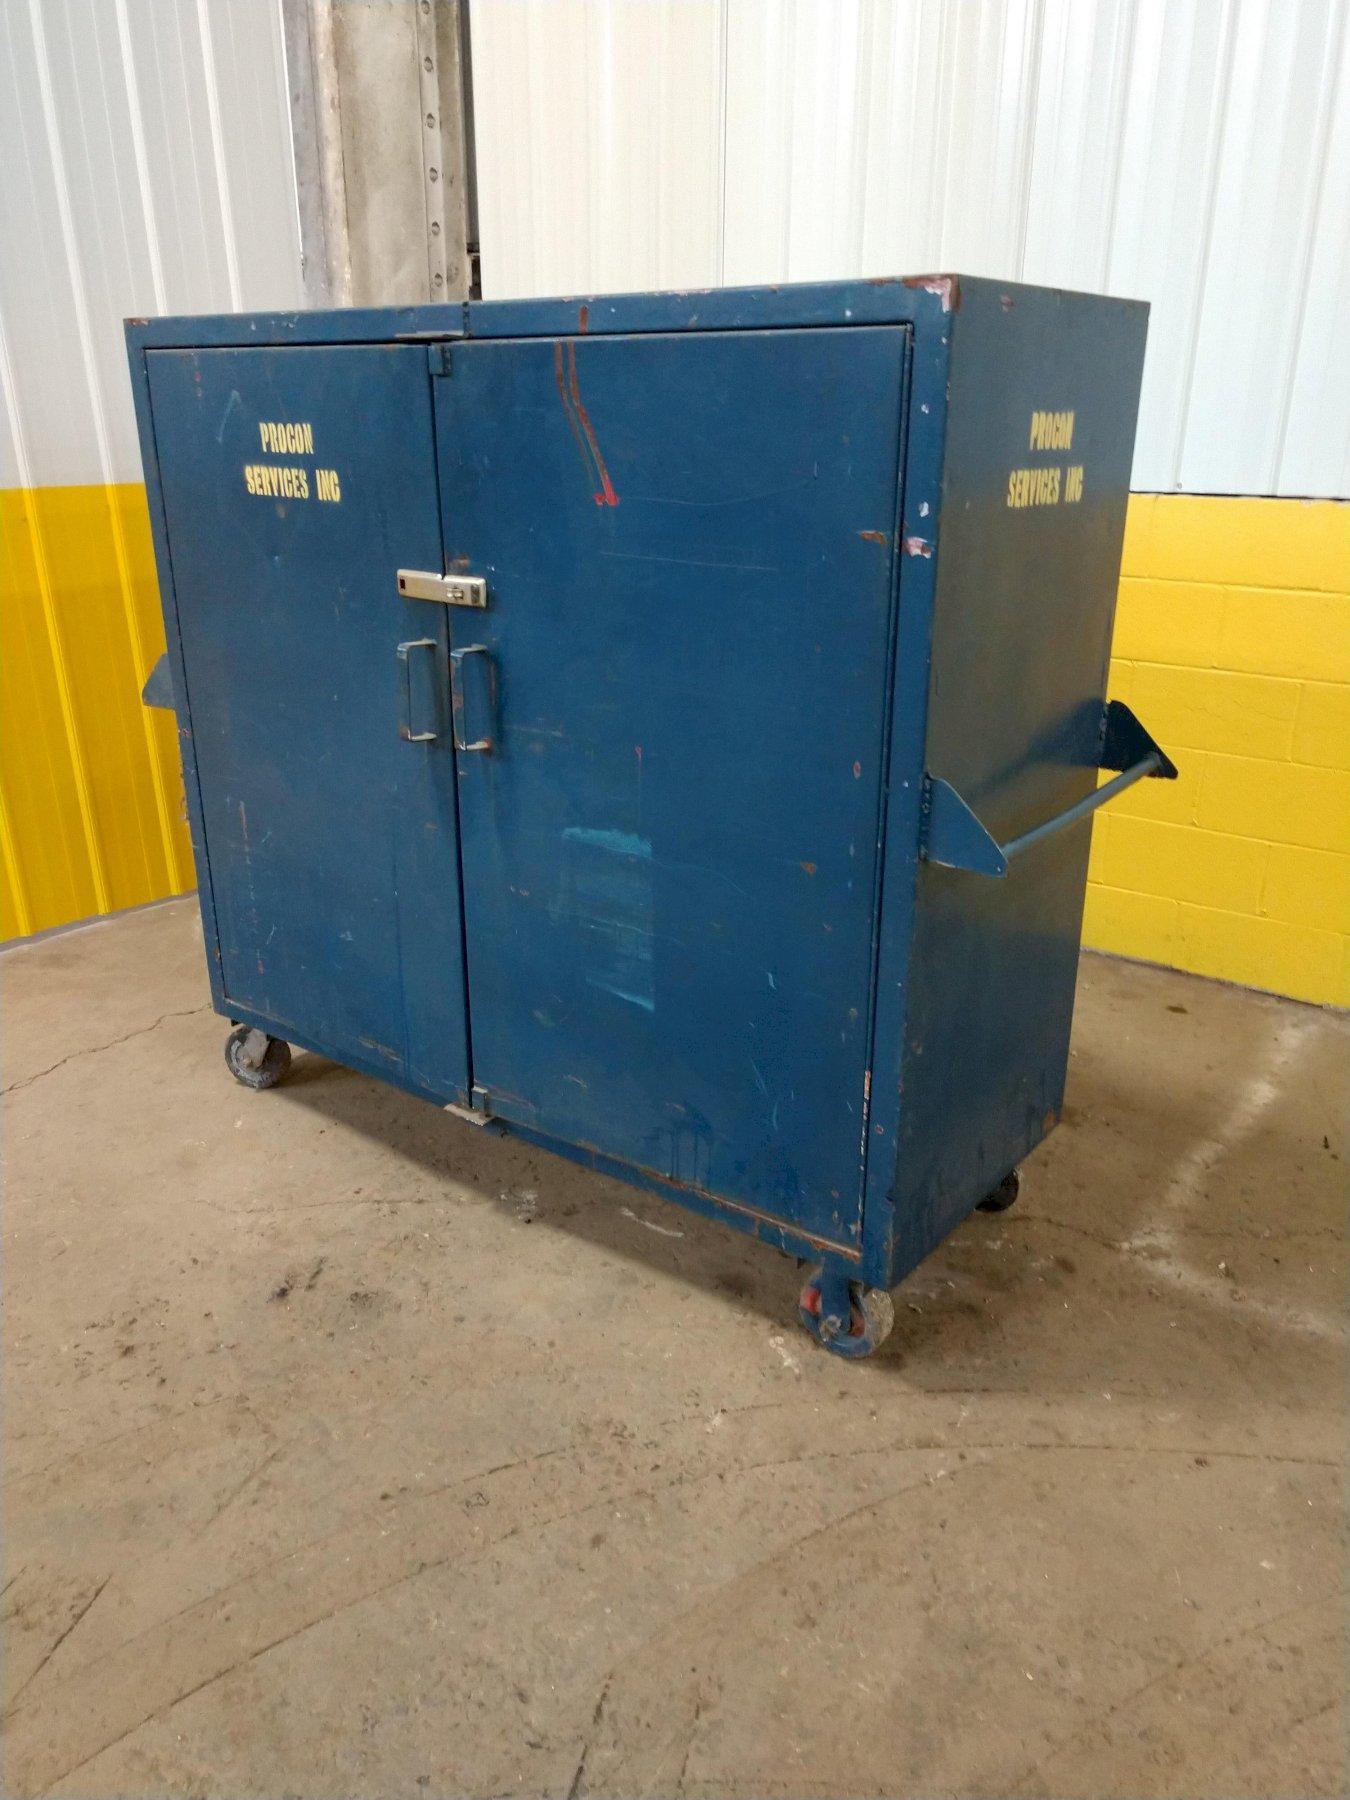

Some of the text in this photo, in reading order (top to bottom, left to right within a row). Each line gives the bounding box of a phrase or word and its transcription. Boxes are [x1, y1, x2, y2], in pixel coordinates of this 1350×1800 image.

[259, 422, 314, 454] PROCON
[1029, 410, 1074, 450] PROCON
[245, 465, 341, 502] SERVICES INC
[1007, 467, 1061, 507] SERVICES
